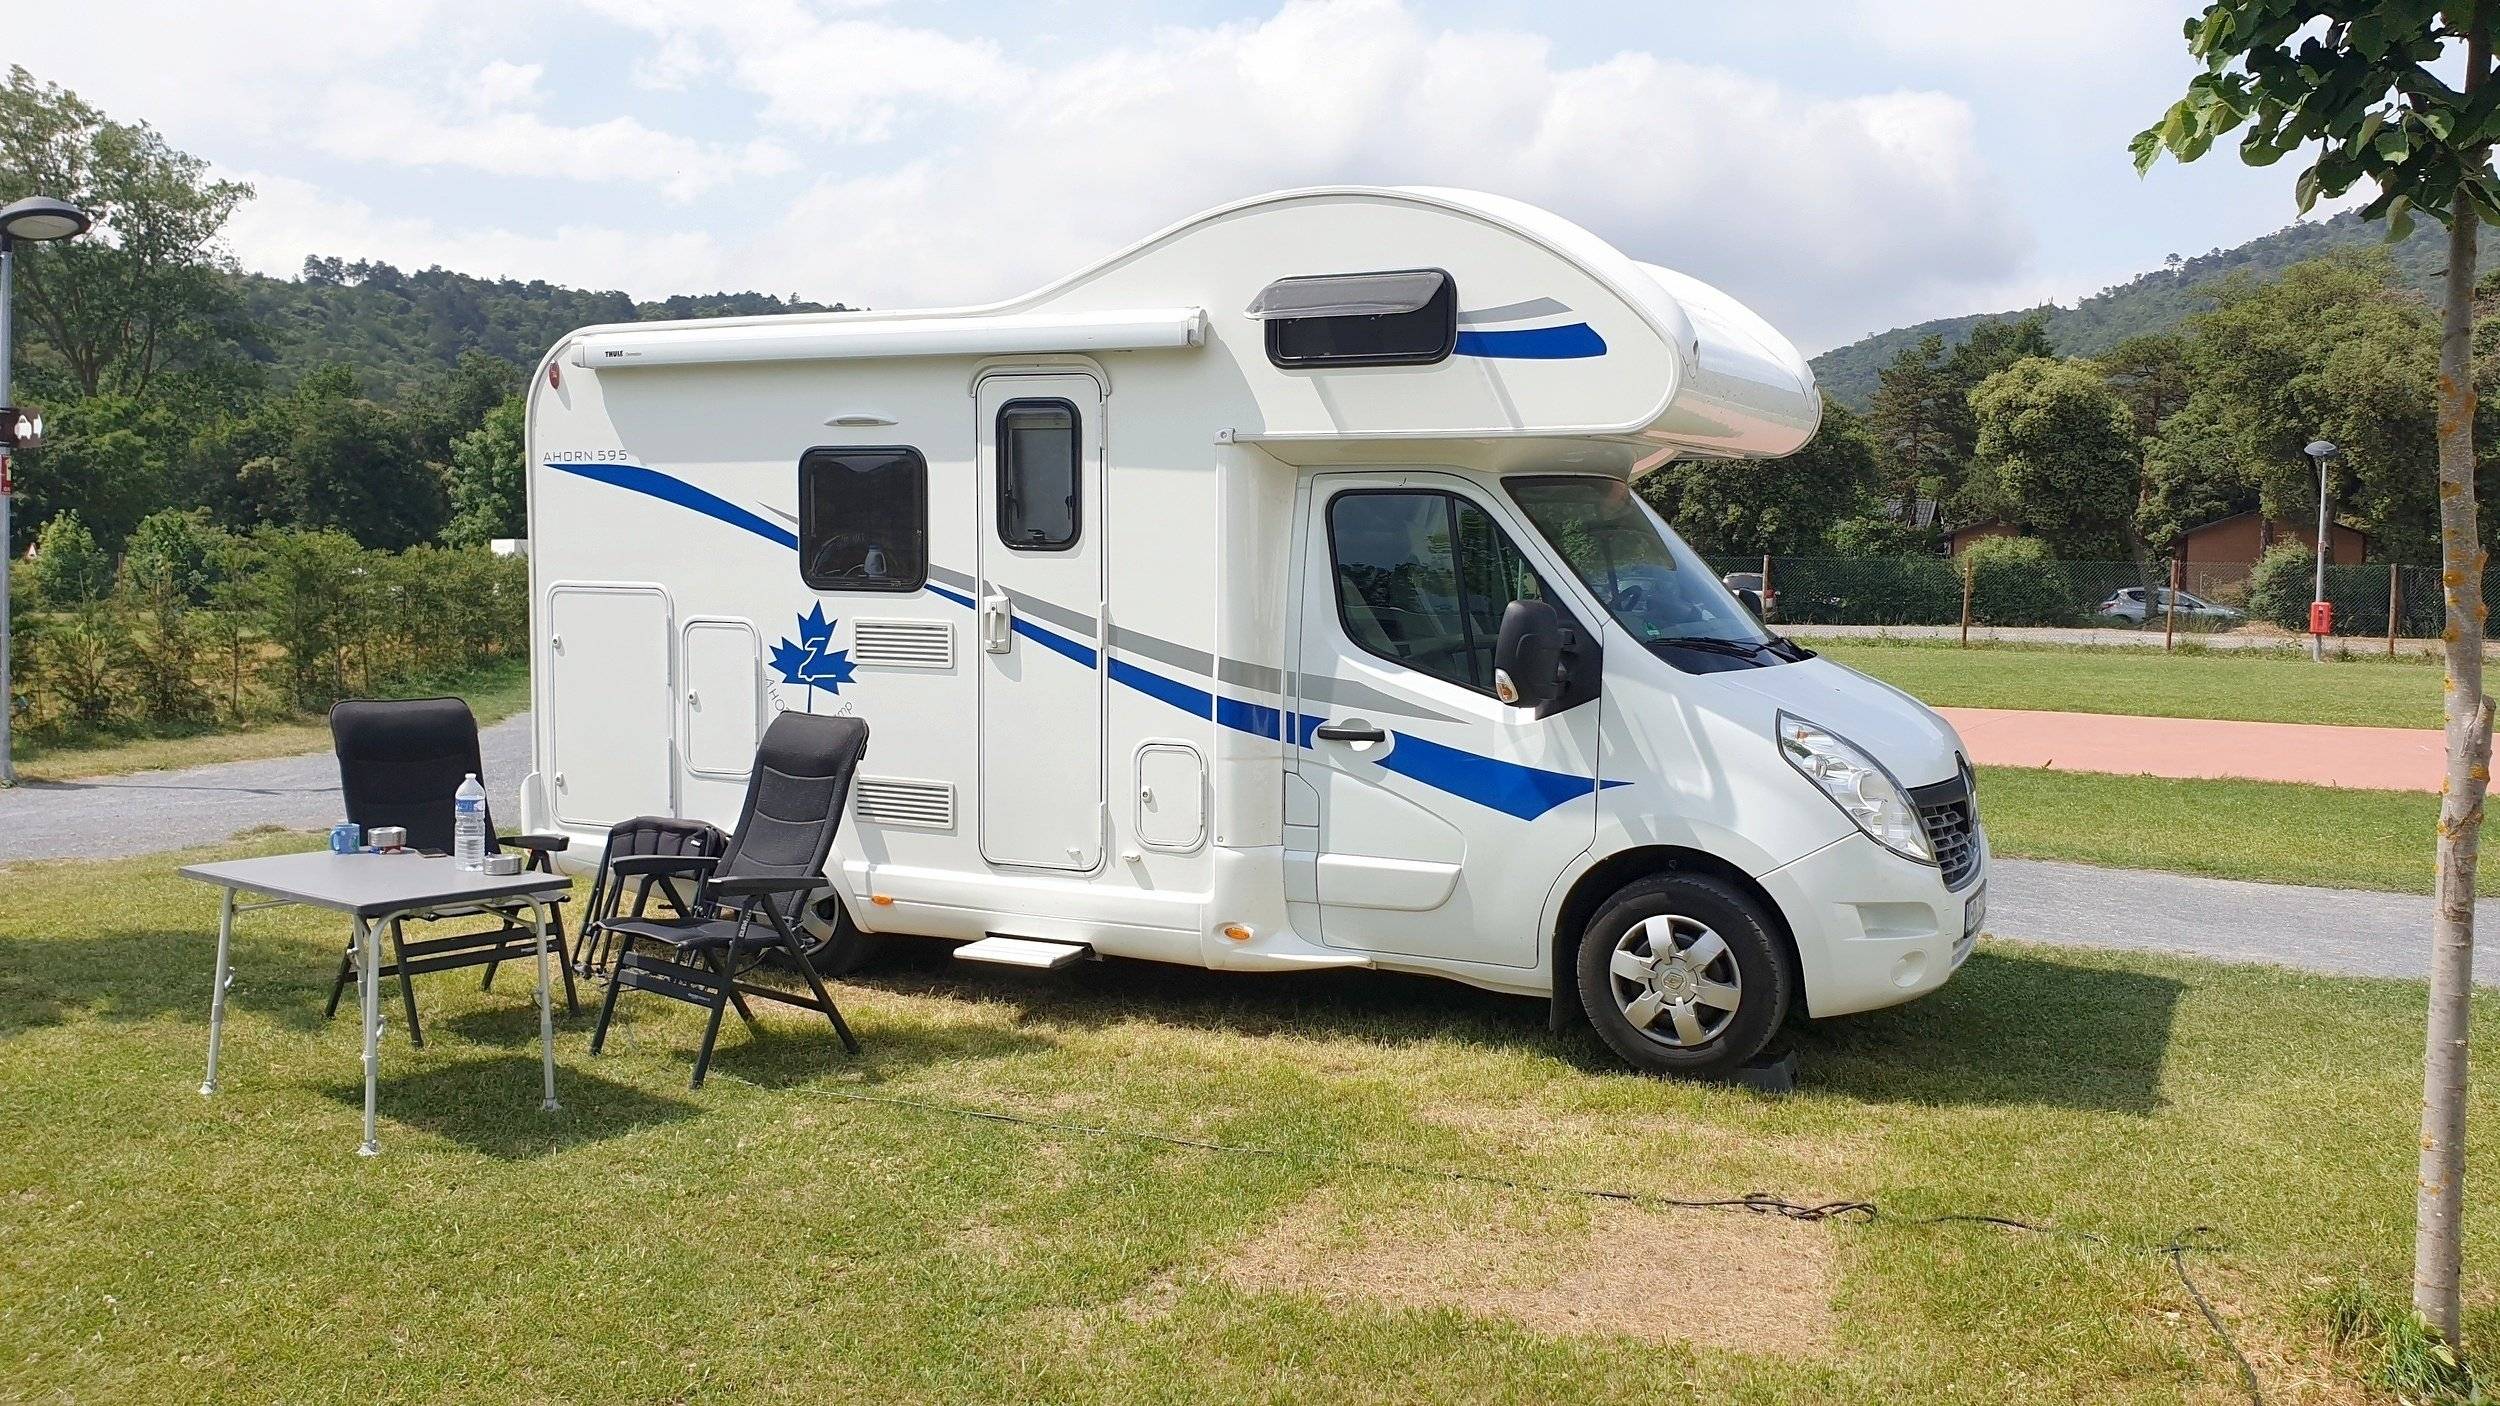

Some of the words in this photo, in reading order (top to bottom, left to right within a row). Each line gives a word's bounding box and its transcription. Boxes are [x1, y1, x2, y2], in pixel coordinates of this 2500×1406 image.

[605, 350, 623, 358] THULE
[543, 451, 593, 462] AHORN
[598, 450, 628, 461] 595
